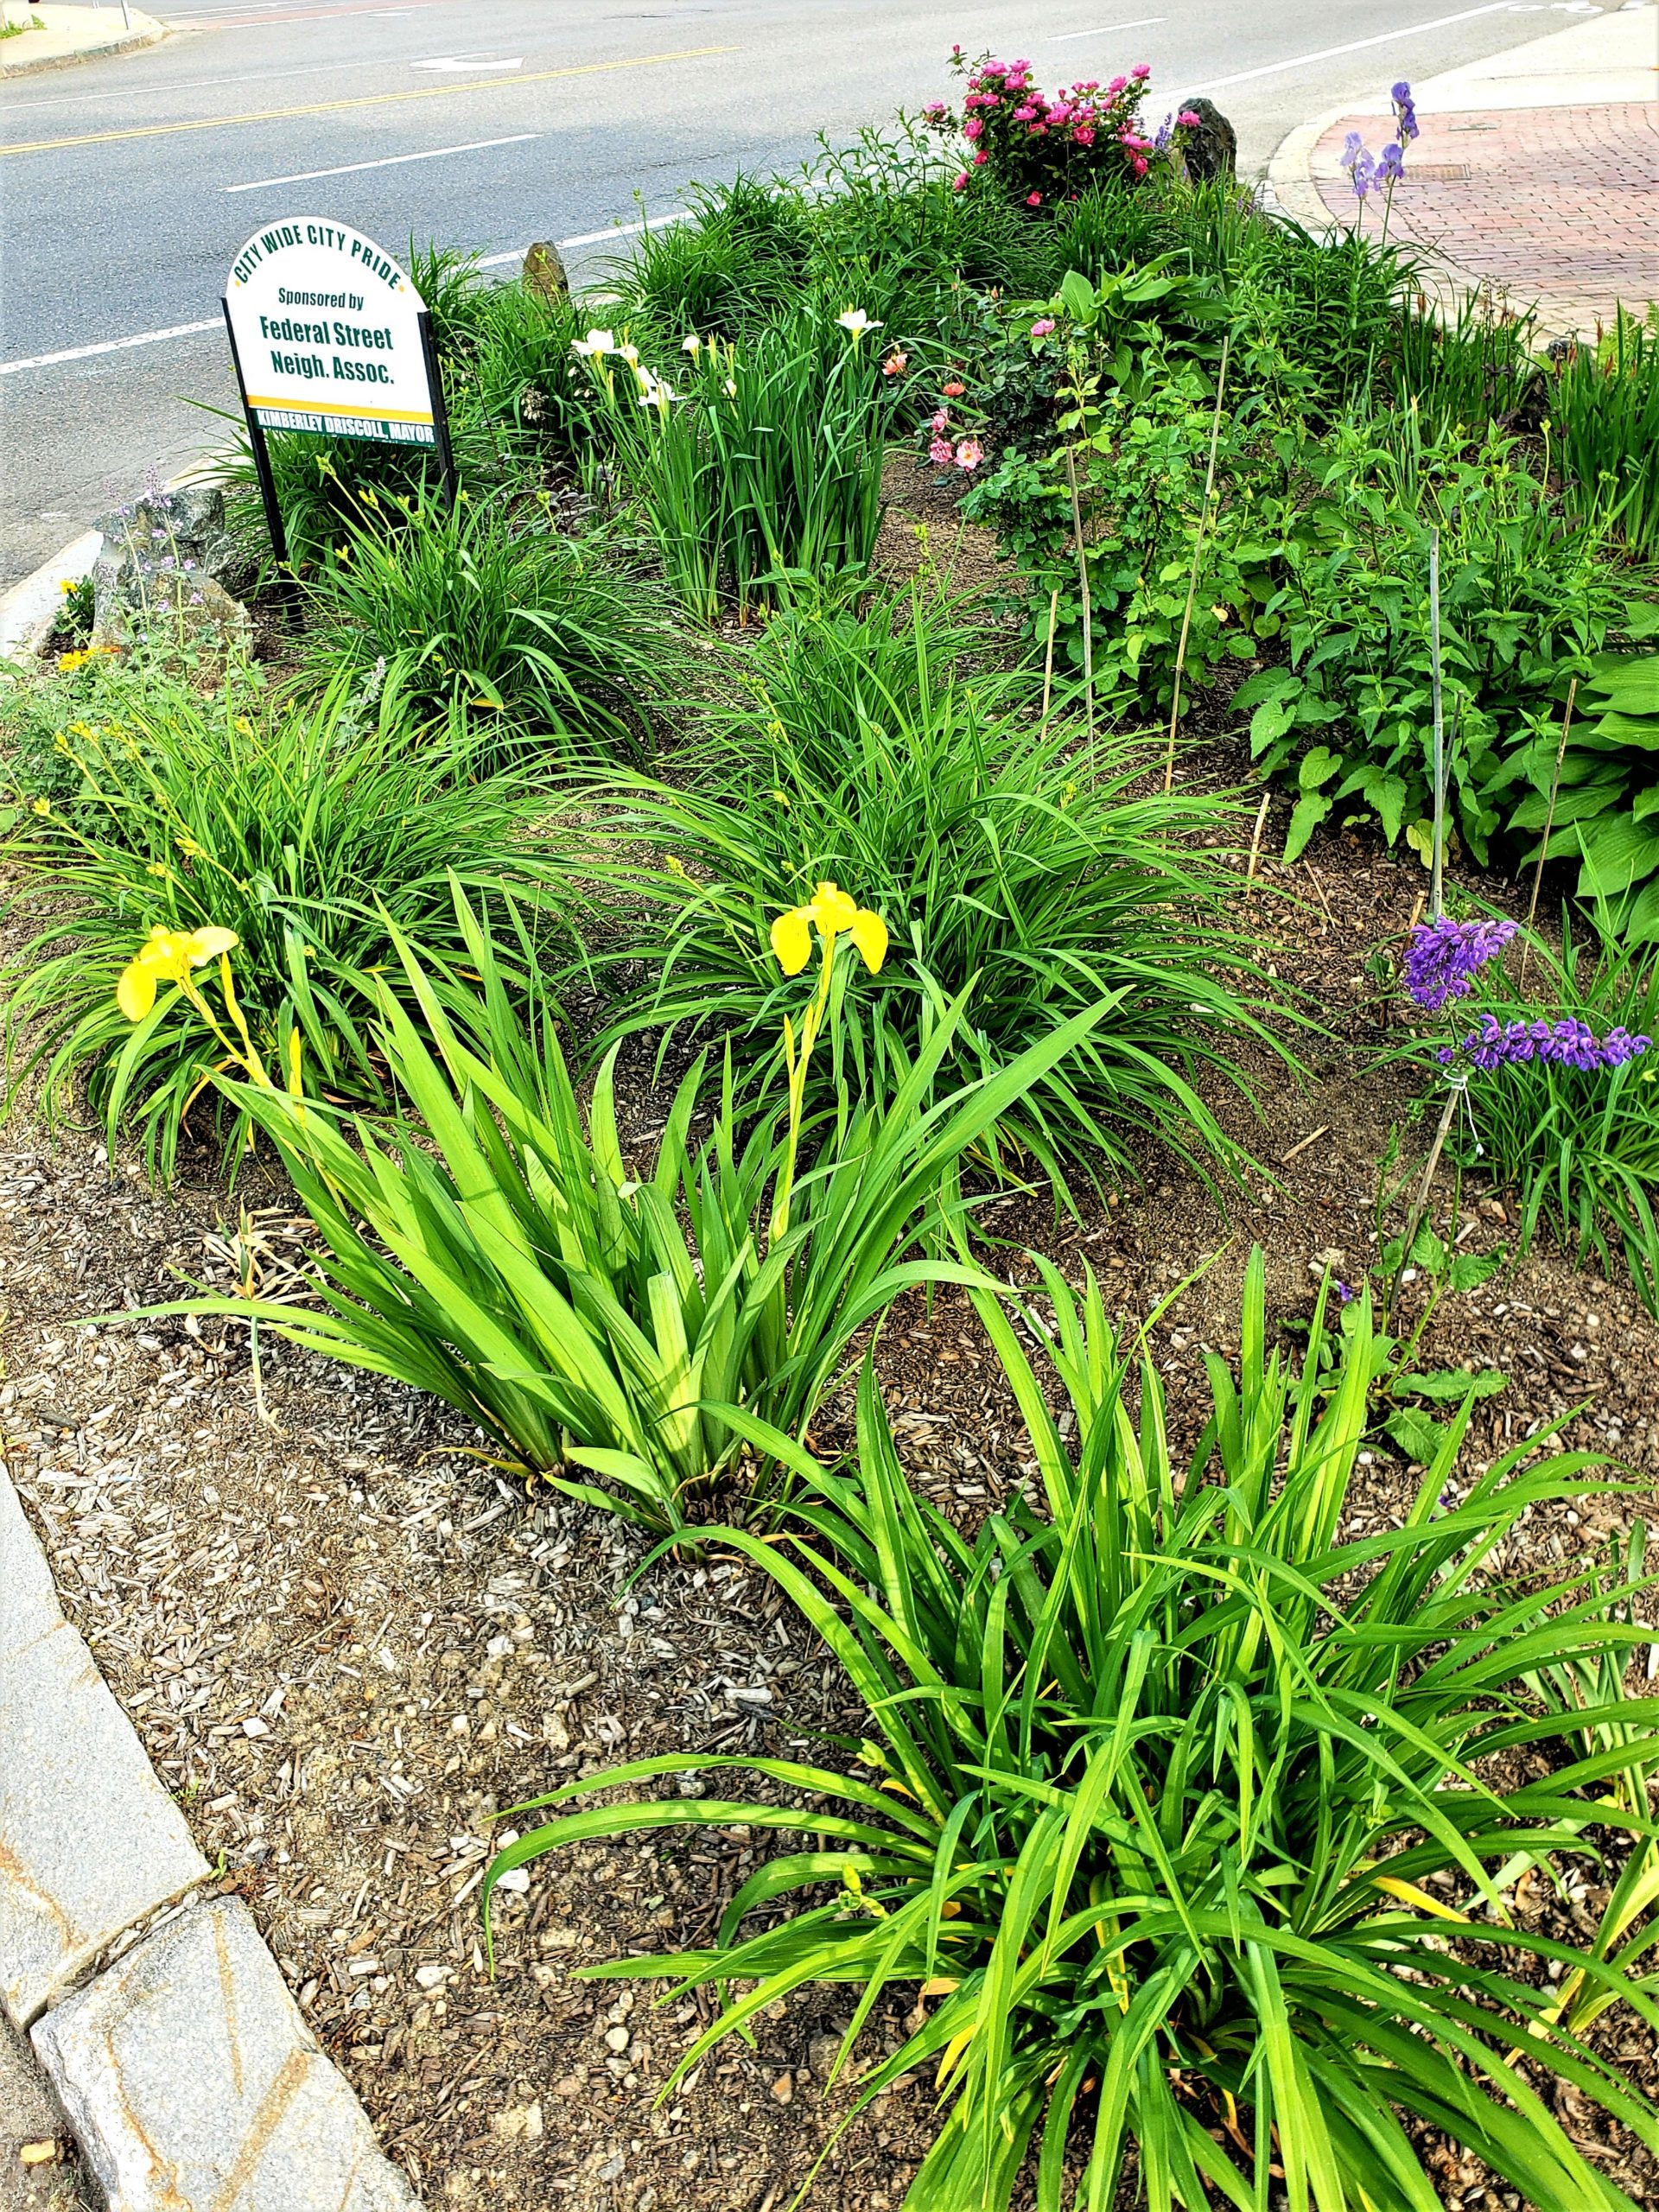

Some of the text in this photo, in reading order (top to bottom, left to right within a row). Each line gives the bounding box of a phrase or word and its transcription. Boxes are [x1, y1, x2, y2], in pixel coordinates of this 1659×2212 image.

[233, 225, 401, 289] CITY WIDE CITY PRIDE
[278, 288, 364, 311] Sponsored by
[259, 316, 393, 350] Federal Street
[270, 350, 395, 385] Neigh. Assoc.
[257, 410, 435, 443] KIMBERLEY DRISCOLL, MAYOR
